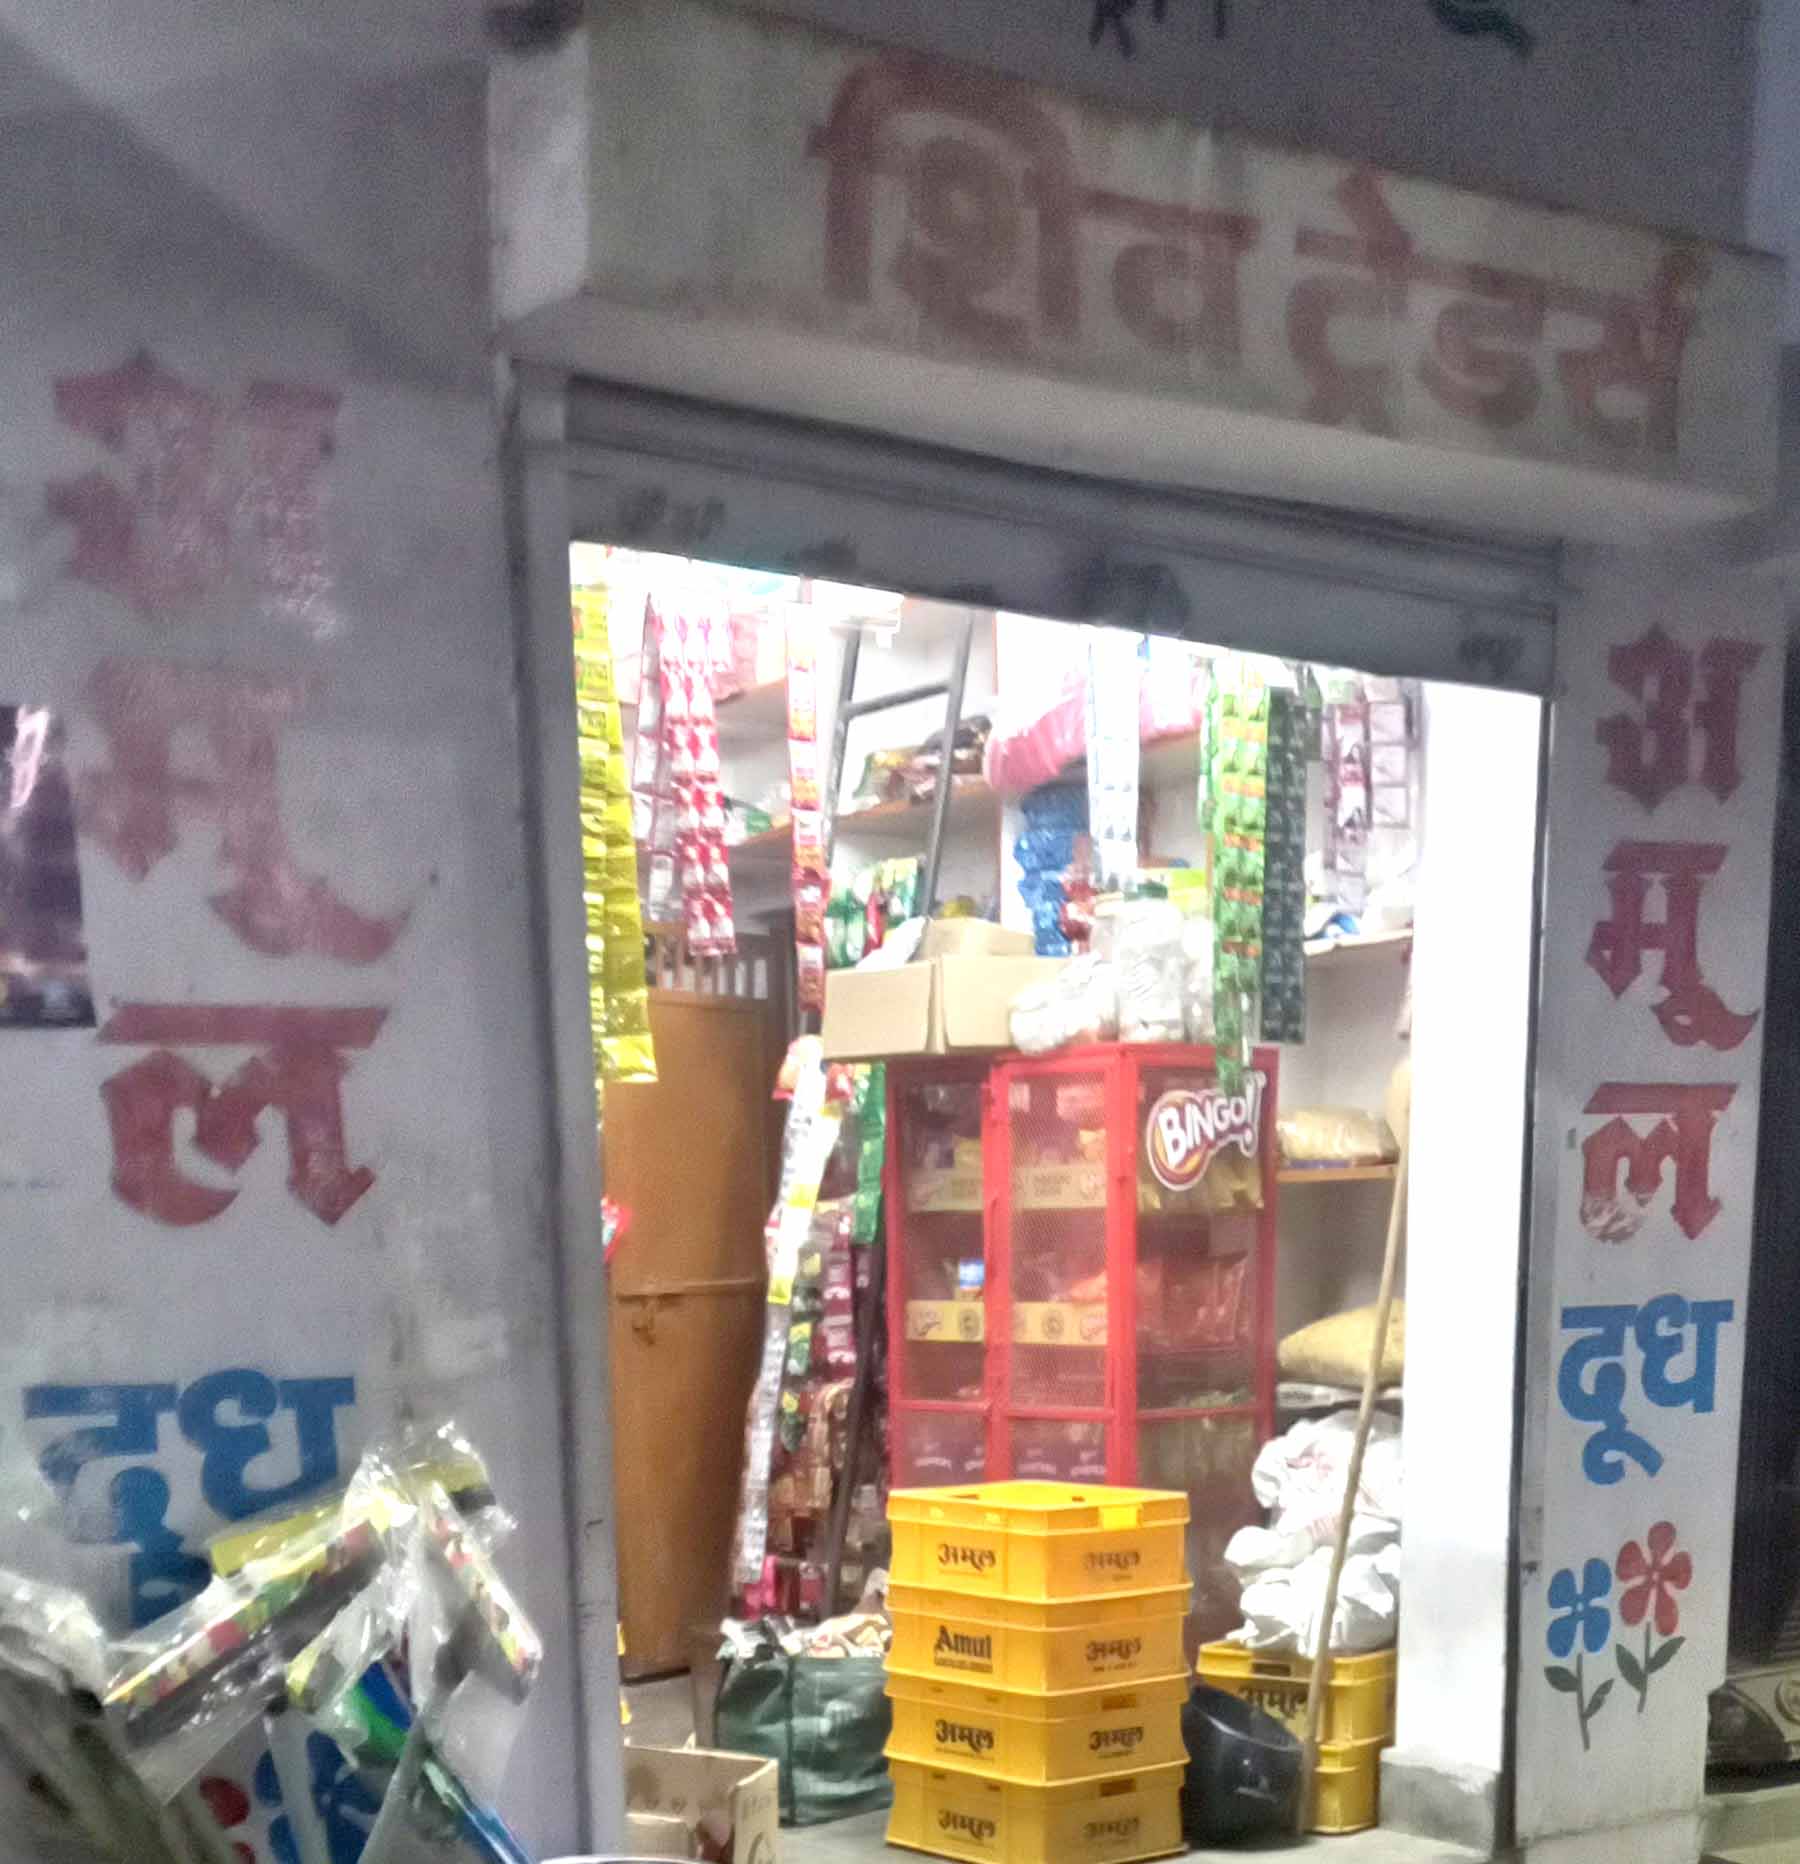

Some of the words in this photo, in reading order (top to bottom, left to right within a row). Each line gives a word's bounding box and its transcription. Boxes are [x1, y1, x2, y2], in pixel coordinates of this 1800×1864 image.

[807, 46, 1260, 372] शिव
[1580, 620, 1766, 1244] अमूल
[1557, 1293, 1735, 1486] दूध
[936, 1541, 998, 1572] अमूल
[933, 1624, 993, 1660] Amul
[1084, 1636, 1142, 1662] अमूल
[934, 1718, 995, 1754] अमूल
[1088, 1724, 1145, 1751] अमूल
[936, 1806, 996, 1841] अमूल
